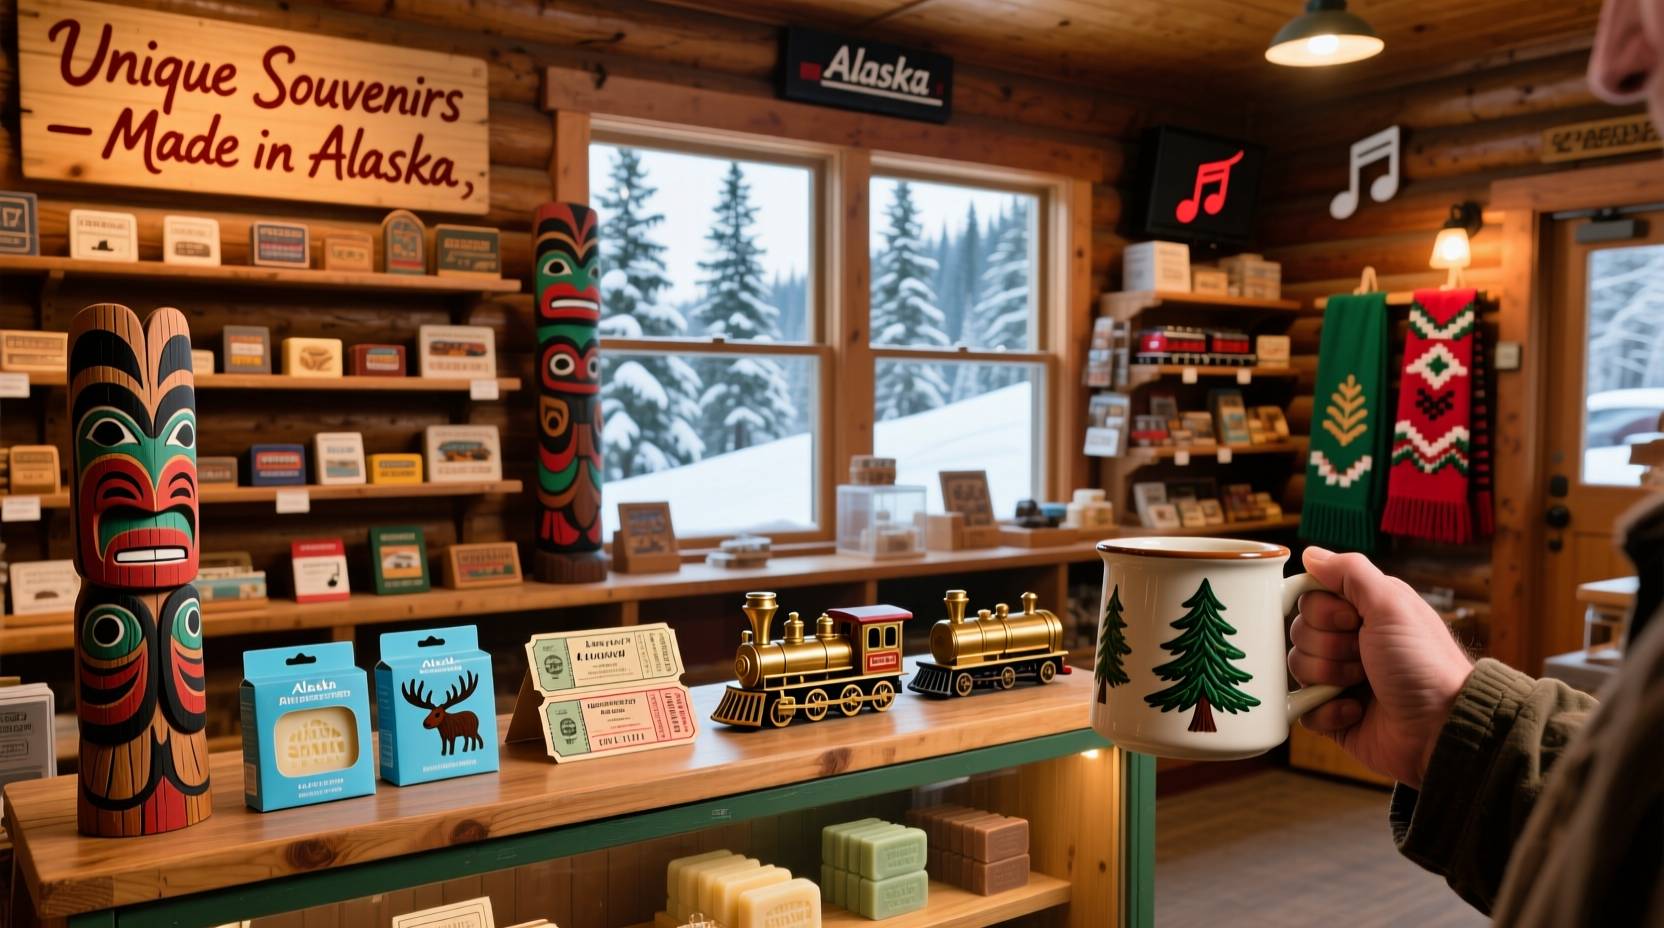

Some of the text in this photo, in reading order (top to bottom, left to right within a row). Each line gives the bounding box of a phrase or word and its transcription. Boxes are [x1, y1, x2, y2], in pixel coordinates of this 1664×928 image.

[48, 18, 464, 122] Unique Souvenirs
[823, 44, 930, 96] Alaska
[101, 108, 239, 175] Made
[254, 129, 294, 172] in
[309, 124, 474, 200] Alaska,
